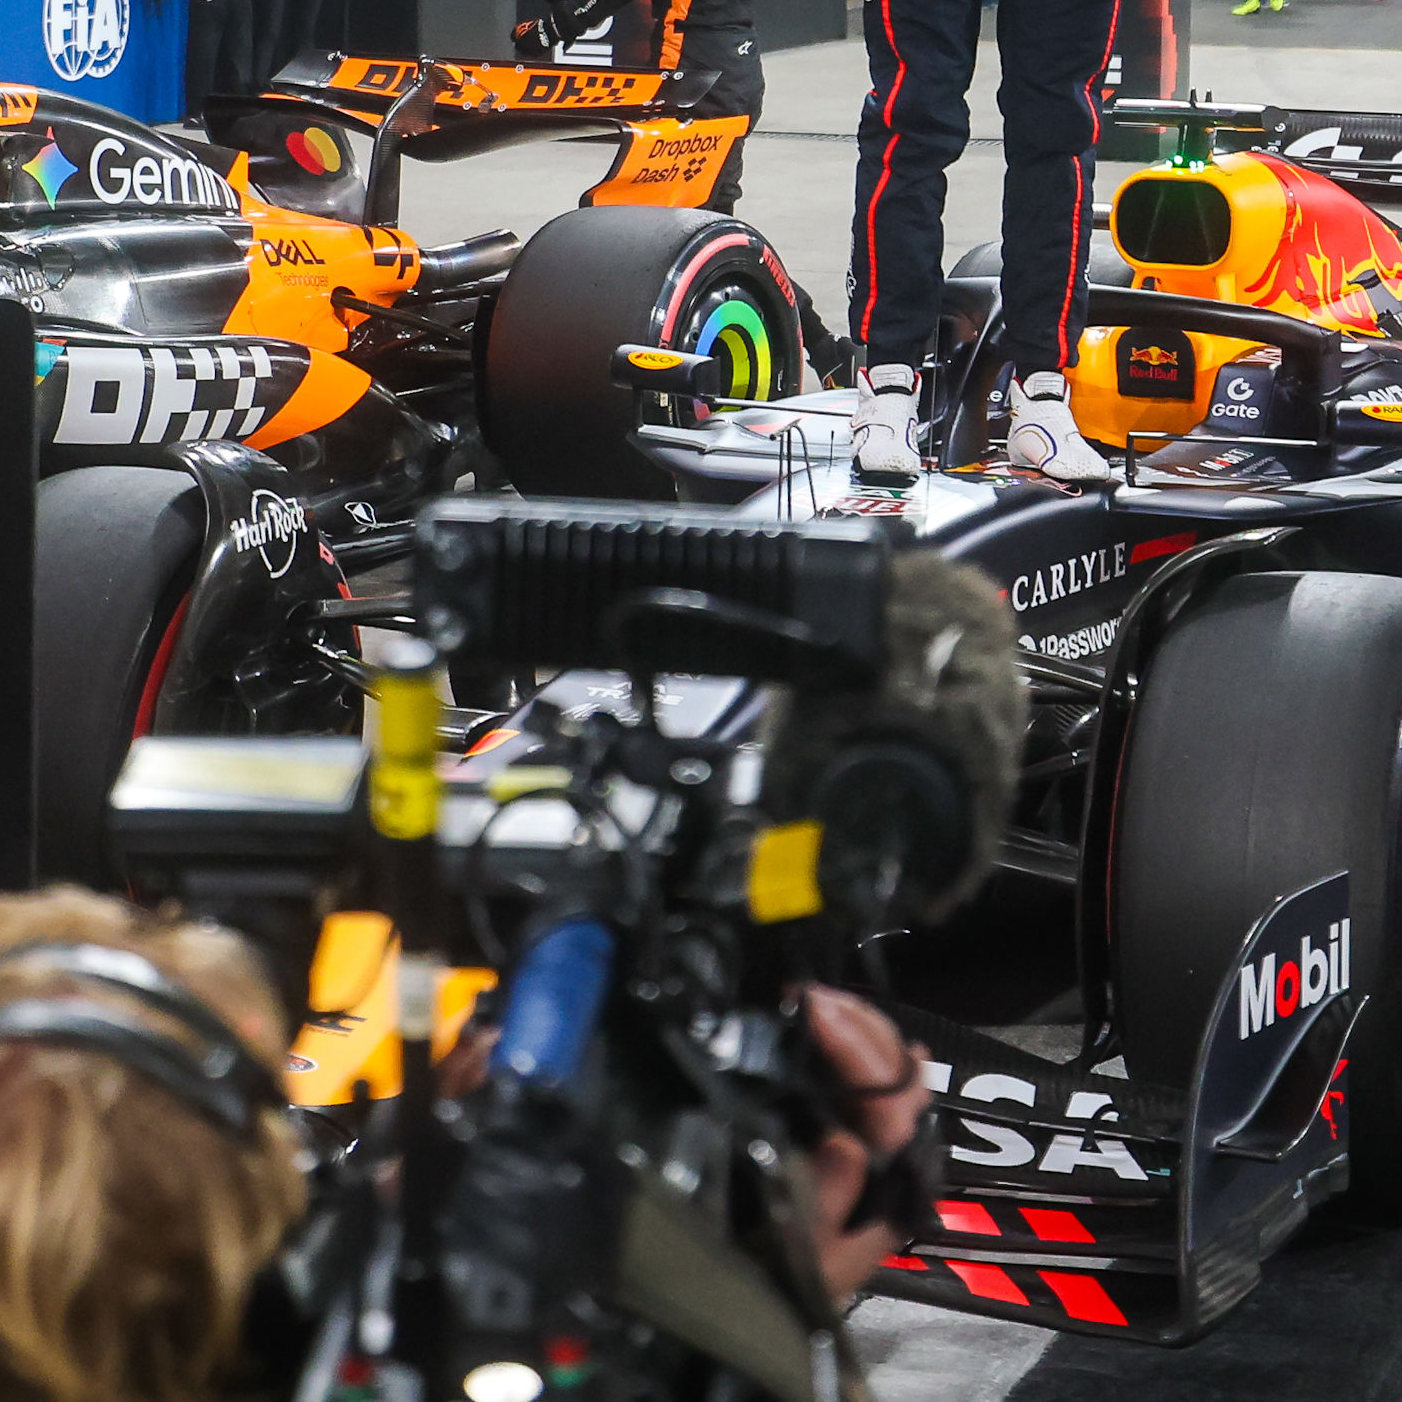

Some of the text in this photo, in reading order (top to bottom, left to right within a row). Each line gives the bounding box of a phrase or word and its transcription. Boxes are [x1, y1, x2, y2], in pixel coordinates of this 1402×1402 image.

[648, 133, 723, 160] Dropbox
[630, 163, 679, 185] Dash
[260, 238, 325, 267] DELL
[276, 271, 330, 289] Technologies
[1130, 366, 1178, 381] Red Bull
[1211, 404, 1260, 419] Gate
[268, 497, 308, 543] Rock
[1011, 542, 1127, 612] CARLYLE
[1039, 615, 1124, 661] 1Passwor
[1239, 917, 1350, 1041] Mobil
[921, 1060, 1149, 1181] SA
